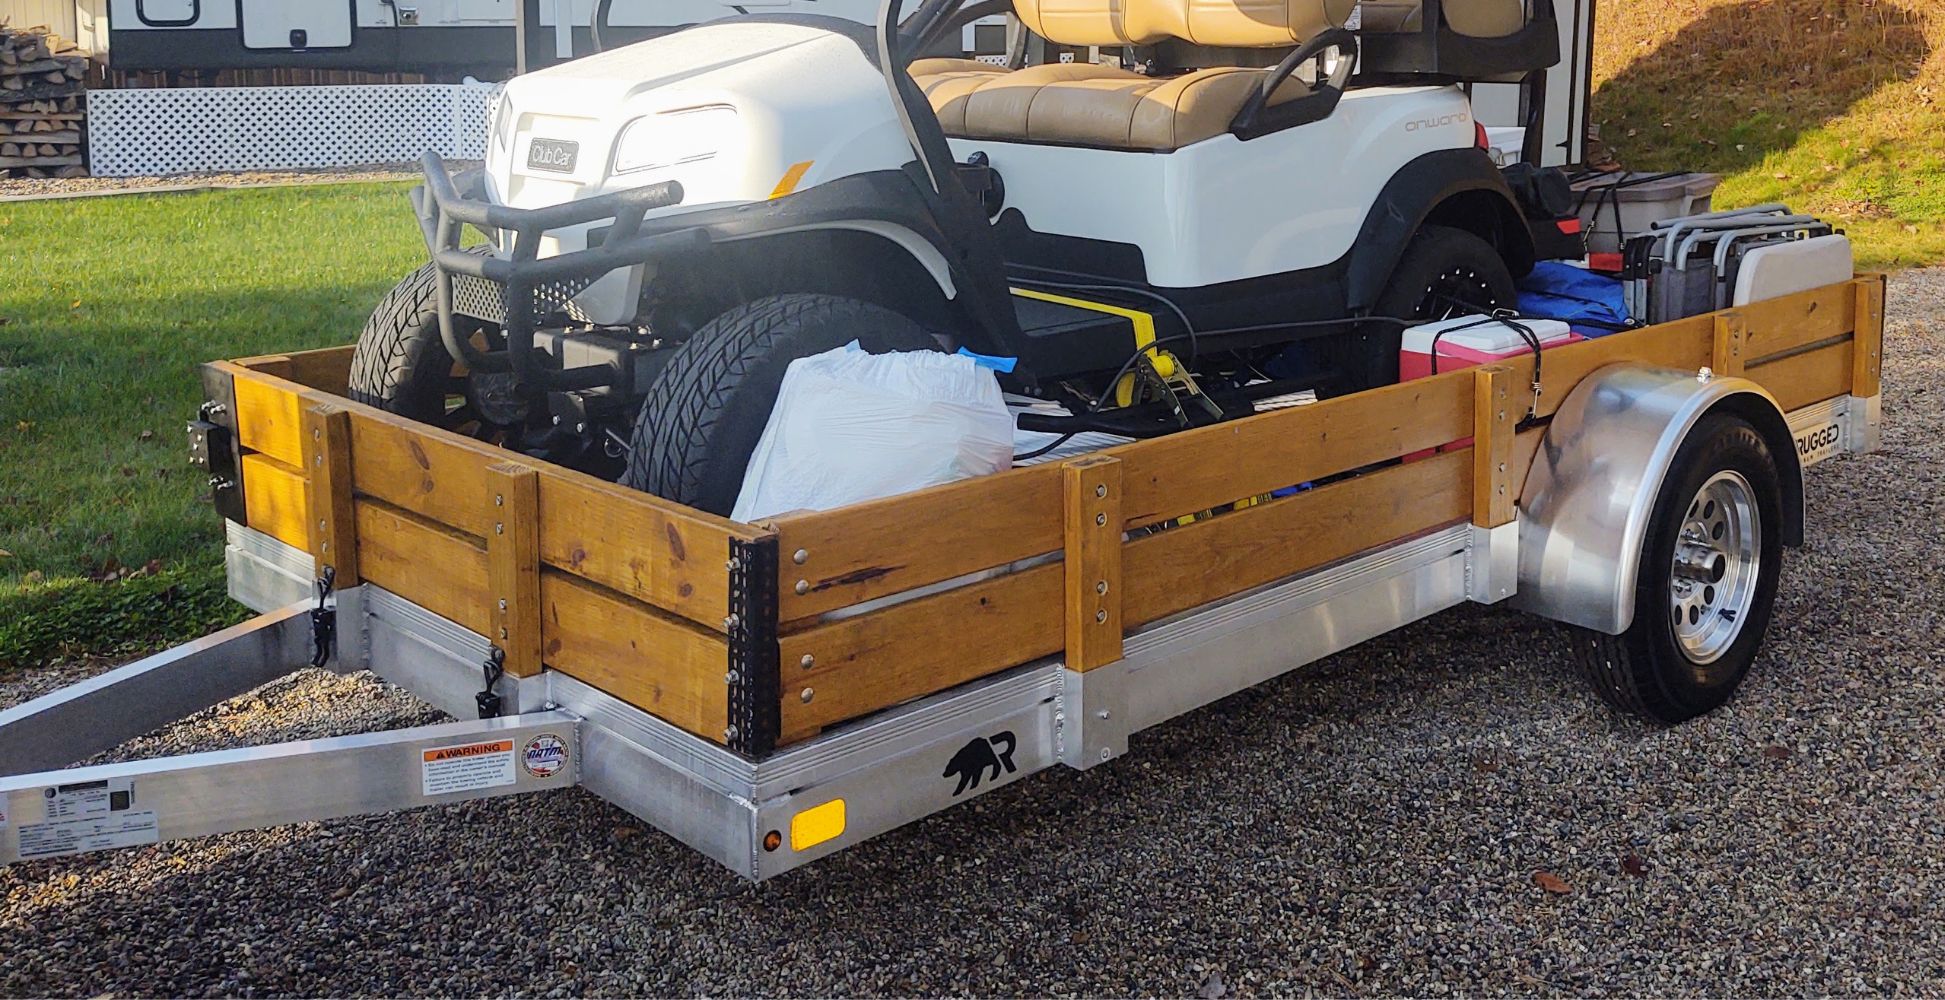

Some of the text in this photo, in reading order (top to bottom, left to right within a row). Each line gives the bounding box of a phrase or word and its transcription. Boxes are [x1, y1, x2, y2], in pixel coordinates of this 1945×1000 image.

[532, 145, 572, 166] Club Car
[1796, 424, 1840, 456] RUGGED
[445, 743, 501, 758] WARNING
